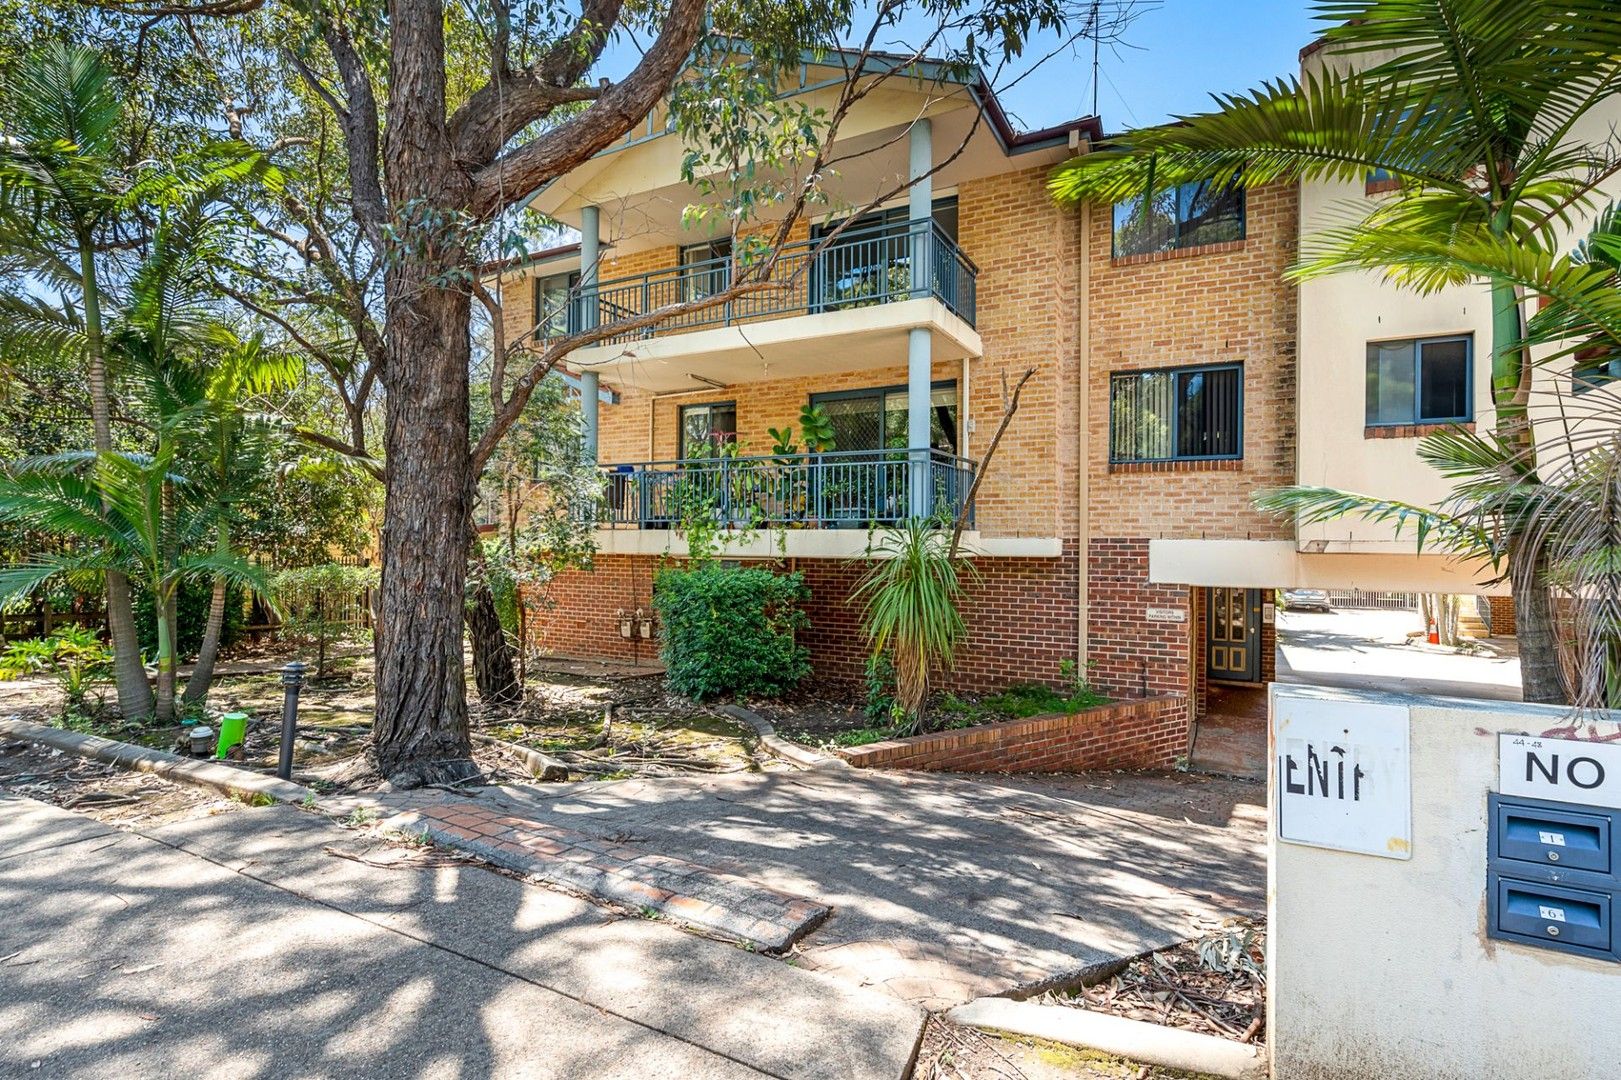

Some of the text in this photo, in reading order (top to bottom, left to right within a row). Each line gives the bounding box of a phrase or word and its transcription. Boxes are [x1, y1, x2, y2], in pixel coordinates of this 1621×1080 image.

[1286, 739, 1385, 801] ENT
[1526, 751, 1605, 789] NO
[1550, 835, 1555, 843] 1
[1548, 910, 1557, 919] 6
